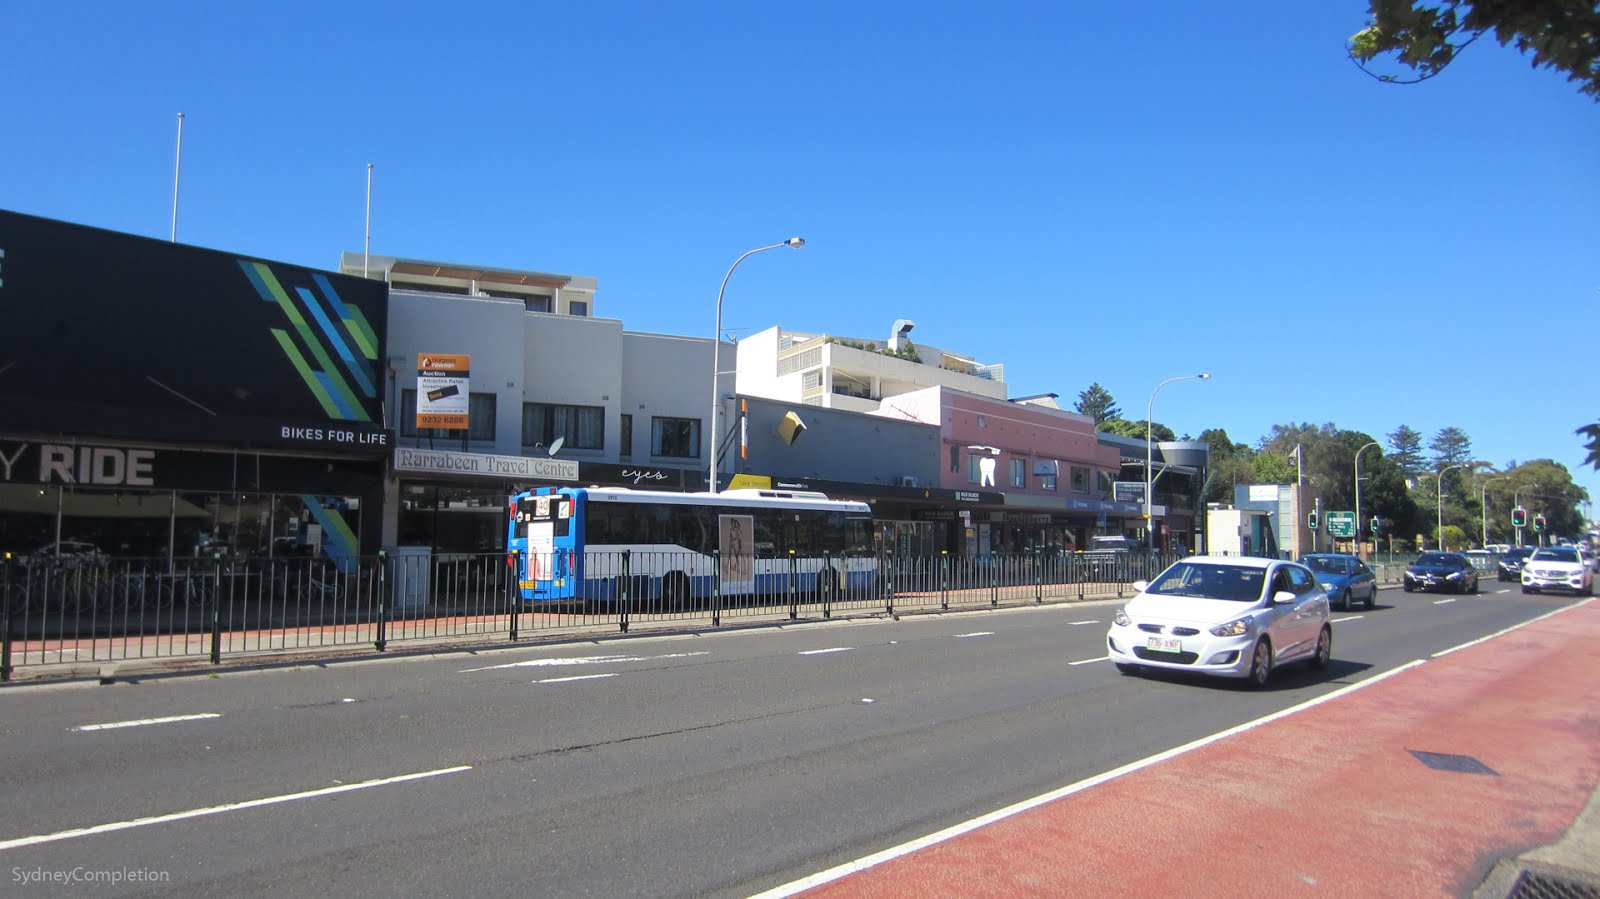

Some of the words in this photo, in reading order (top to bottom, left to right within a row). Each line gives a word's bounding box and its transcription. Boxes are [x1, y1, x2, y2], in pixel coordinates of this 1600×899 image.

[422, 416, 442, 424] 9232
[281, 426, 324, 441] BIKES
[328, 430, 355, 442] FOR
[359, 432, 387, 445] LIFE
[40, 444, 155, 486] RIDE
[400, 449, 479, 471] Narrabeen
[485, 456, 529, 475] Travel
[534, 460, 575, 477] Centre
[621, 468, 668, 484] eyes
[538, 501, 547, 510] 40
